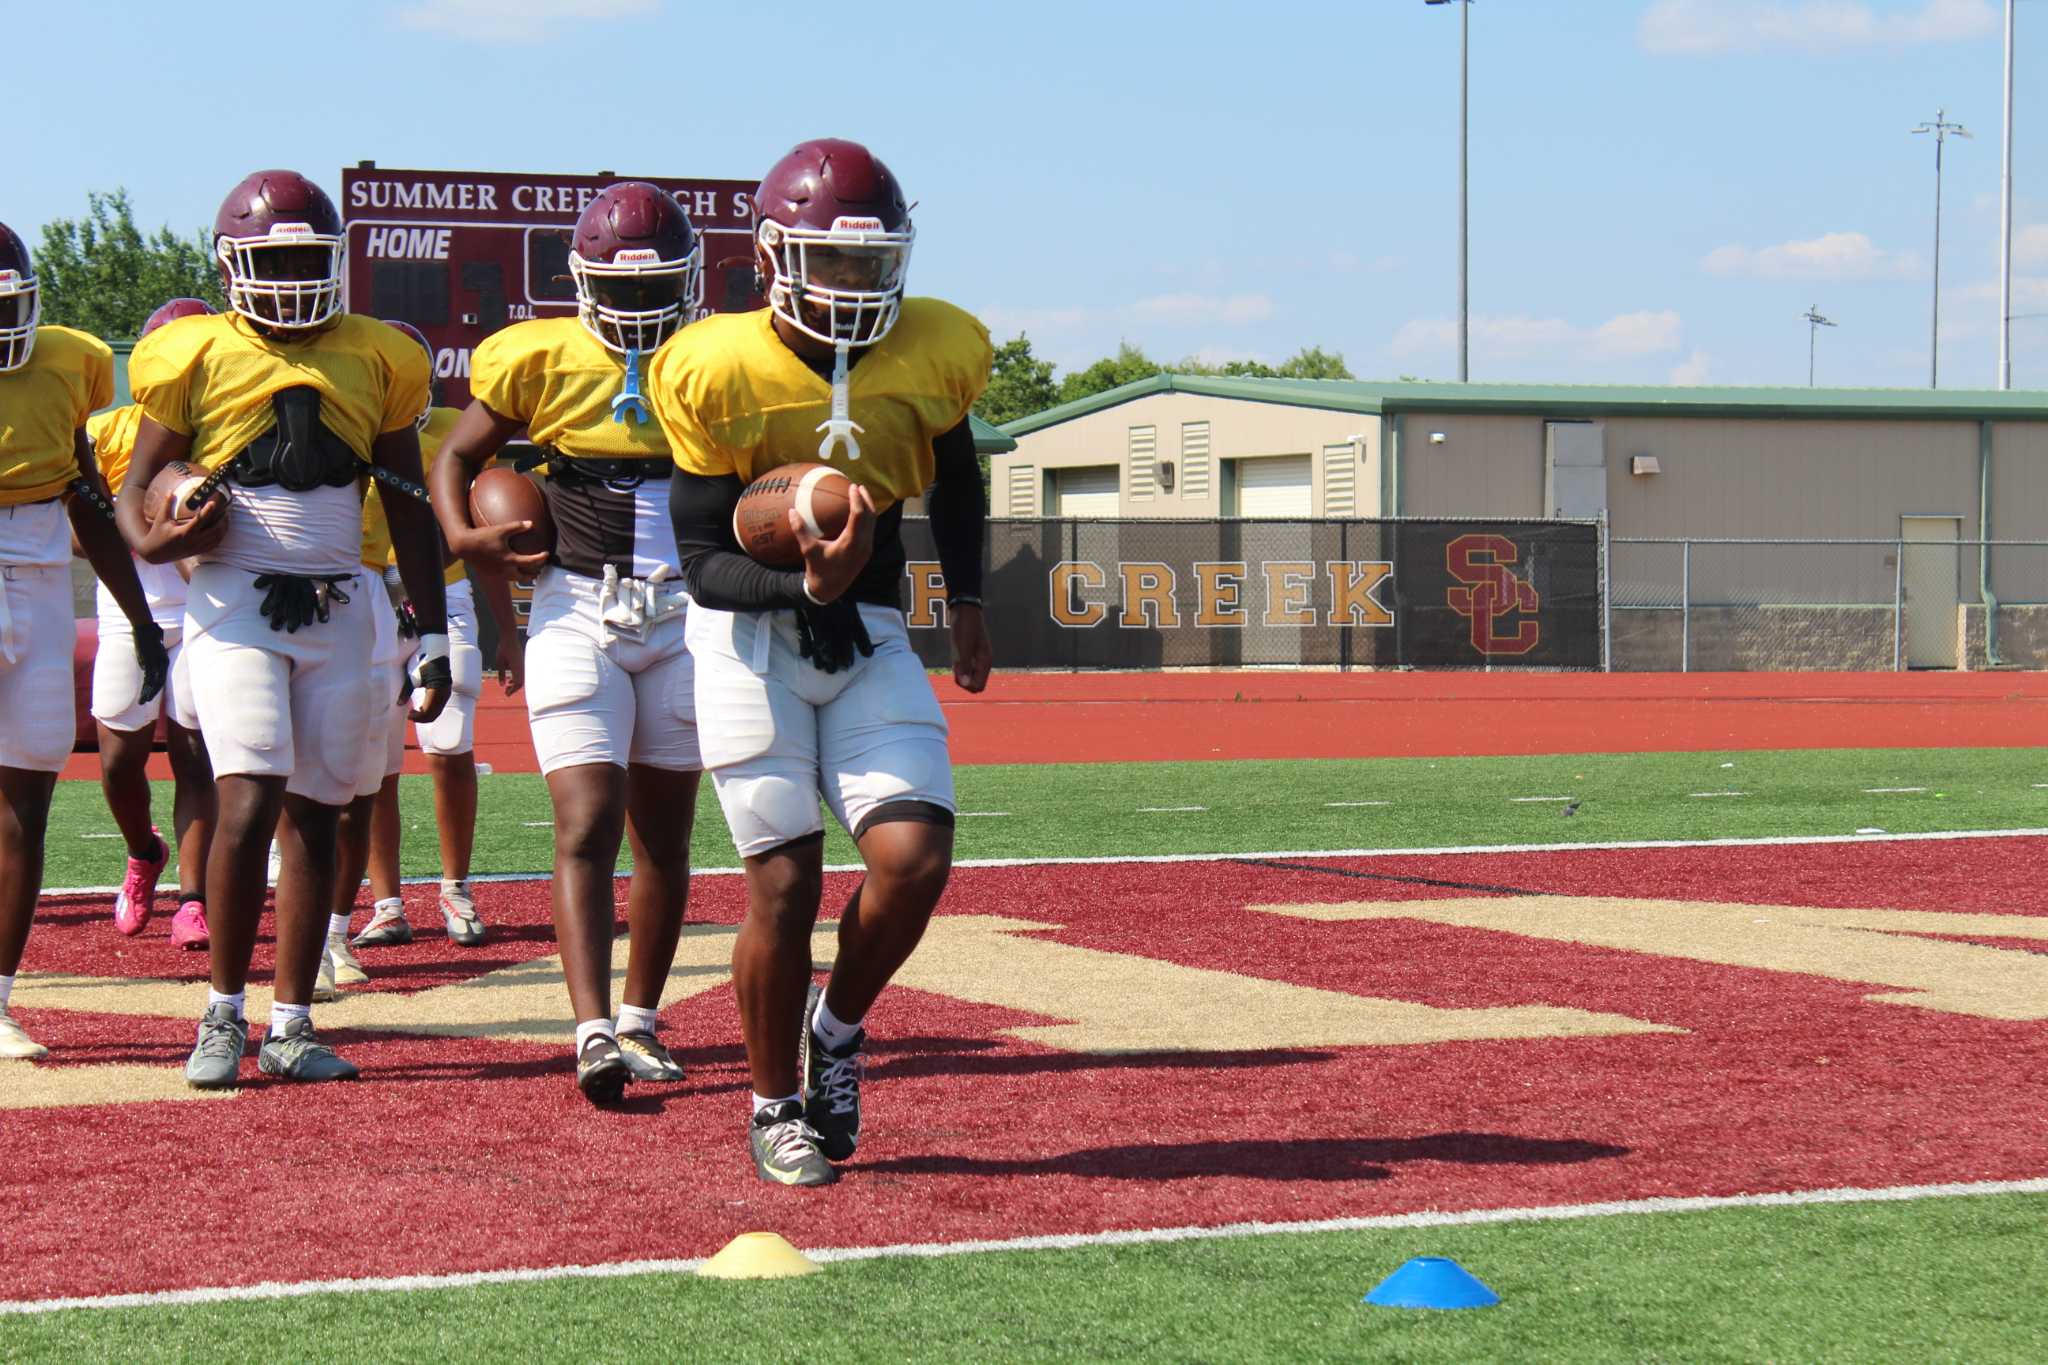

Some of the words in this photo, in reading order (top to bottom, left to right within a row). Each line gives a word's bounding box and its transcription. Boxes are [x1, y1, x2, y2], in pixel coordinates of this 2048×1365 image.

[351, 181, 498, 211] SUMMER
[512, 186, 606, 213] CREE
[840, 220, 880, 230] Riddell
[366, 228, 452, 260] HOME
[620, 253, 655, 262] Riddell
[508, 304, 537, 320] T.O.L.
[1050, 561, 1394, 628] CREEK
